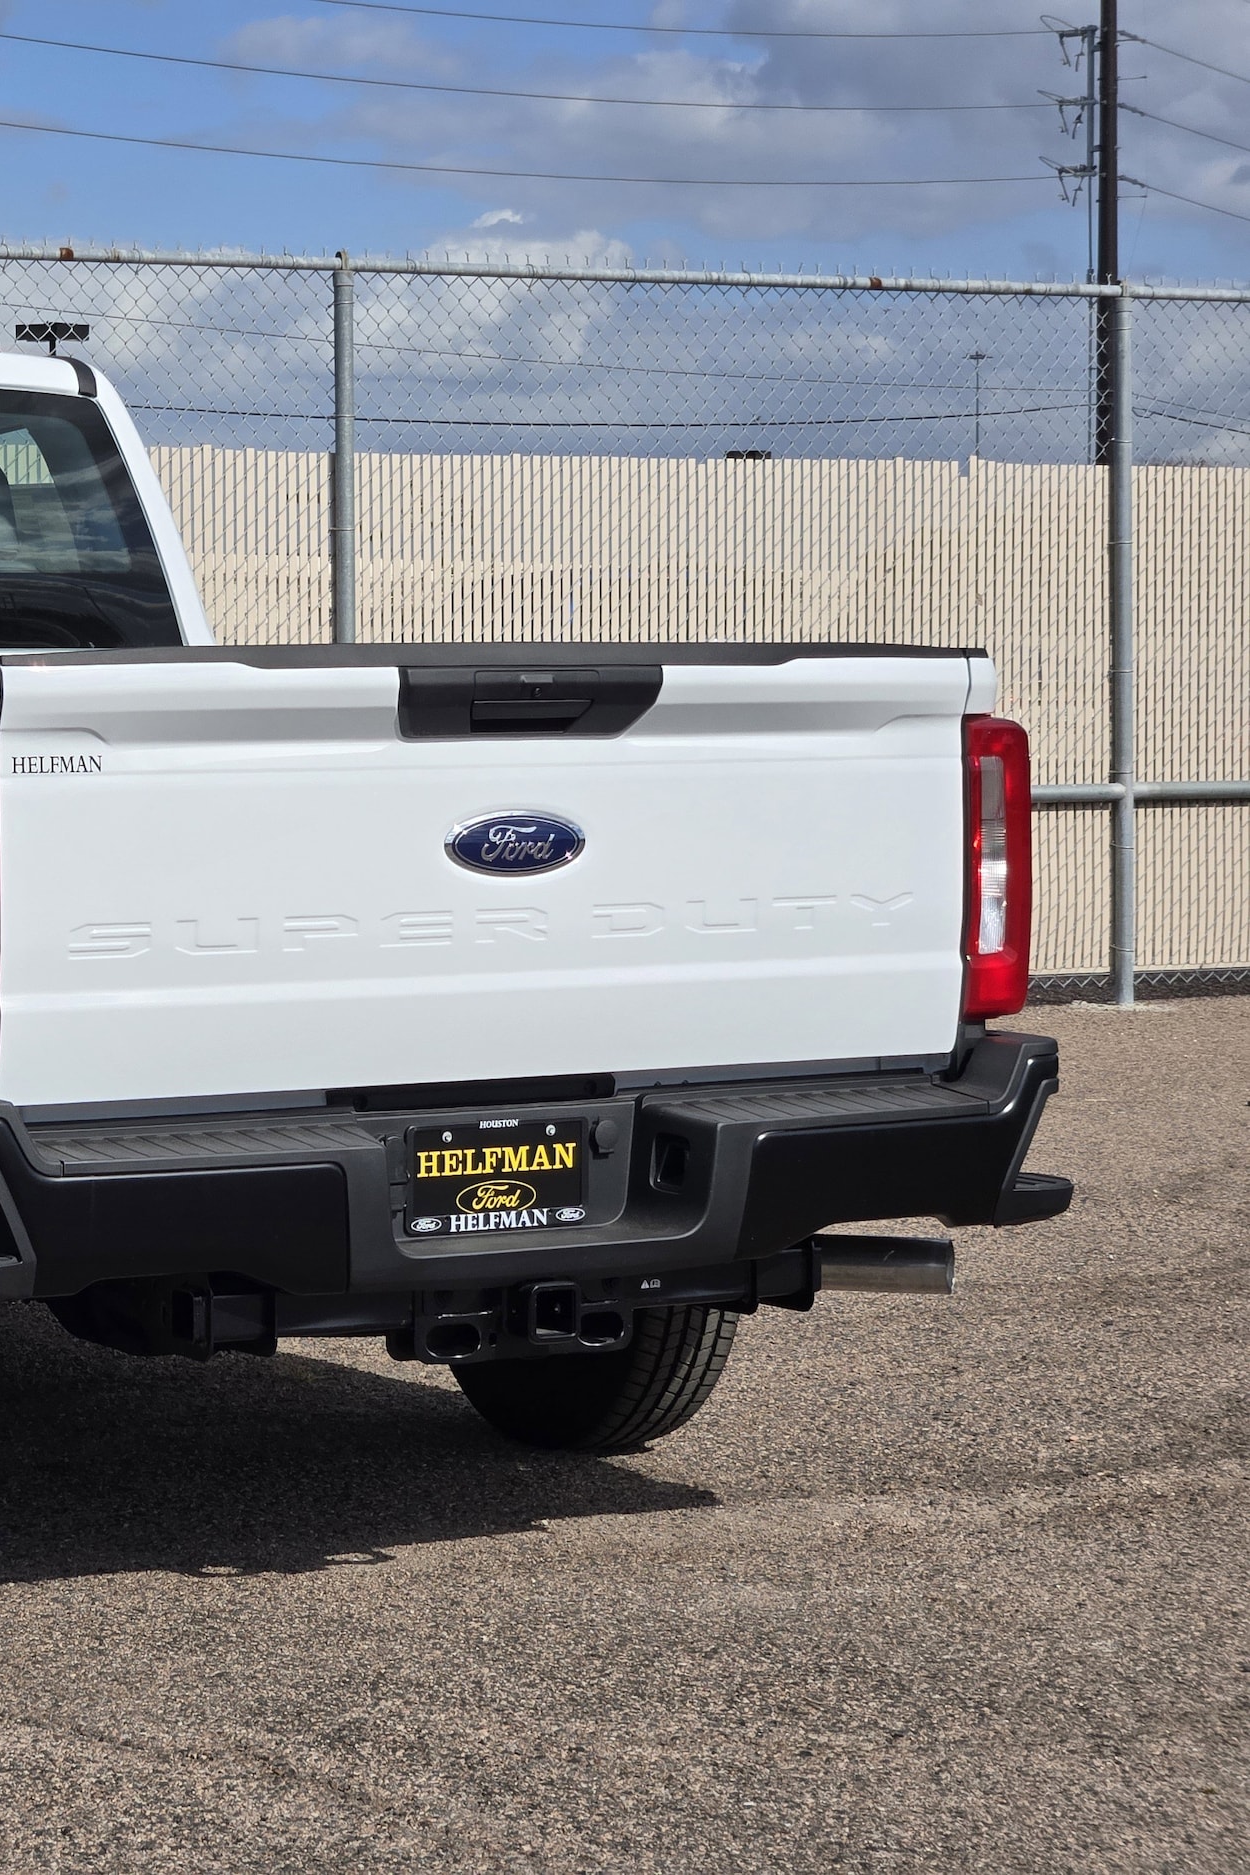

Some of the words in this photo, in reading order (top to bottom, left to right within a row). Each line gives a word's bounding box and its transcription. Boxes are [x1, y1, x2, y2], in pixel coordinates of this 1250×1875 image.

[11, 755, 102, 774] HELFMAN
[480, 825, 555, 862] Ford
[67, 906, 548, 961] SUPER
[591, 891, 914, 939] DUTY
[479, 1119, 519, 1129] HOUSTON
[417, 1142, 577, 1178] HELFMAN
[472, 1184, 521, 1210] Ford
[450, 1208, 550, 1233] HELFMAN
